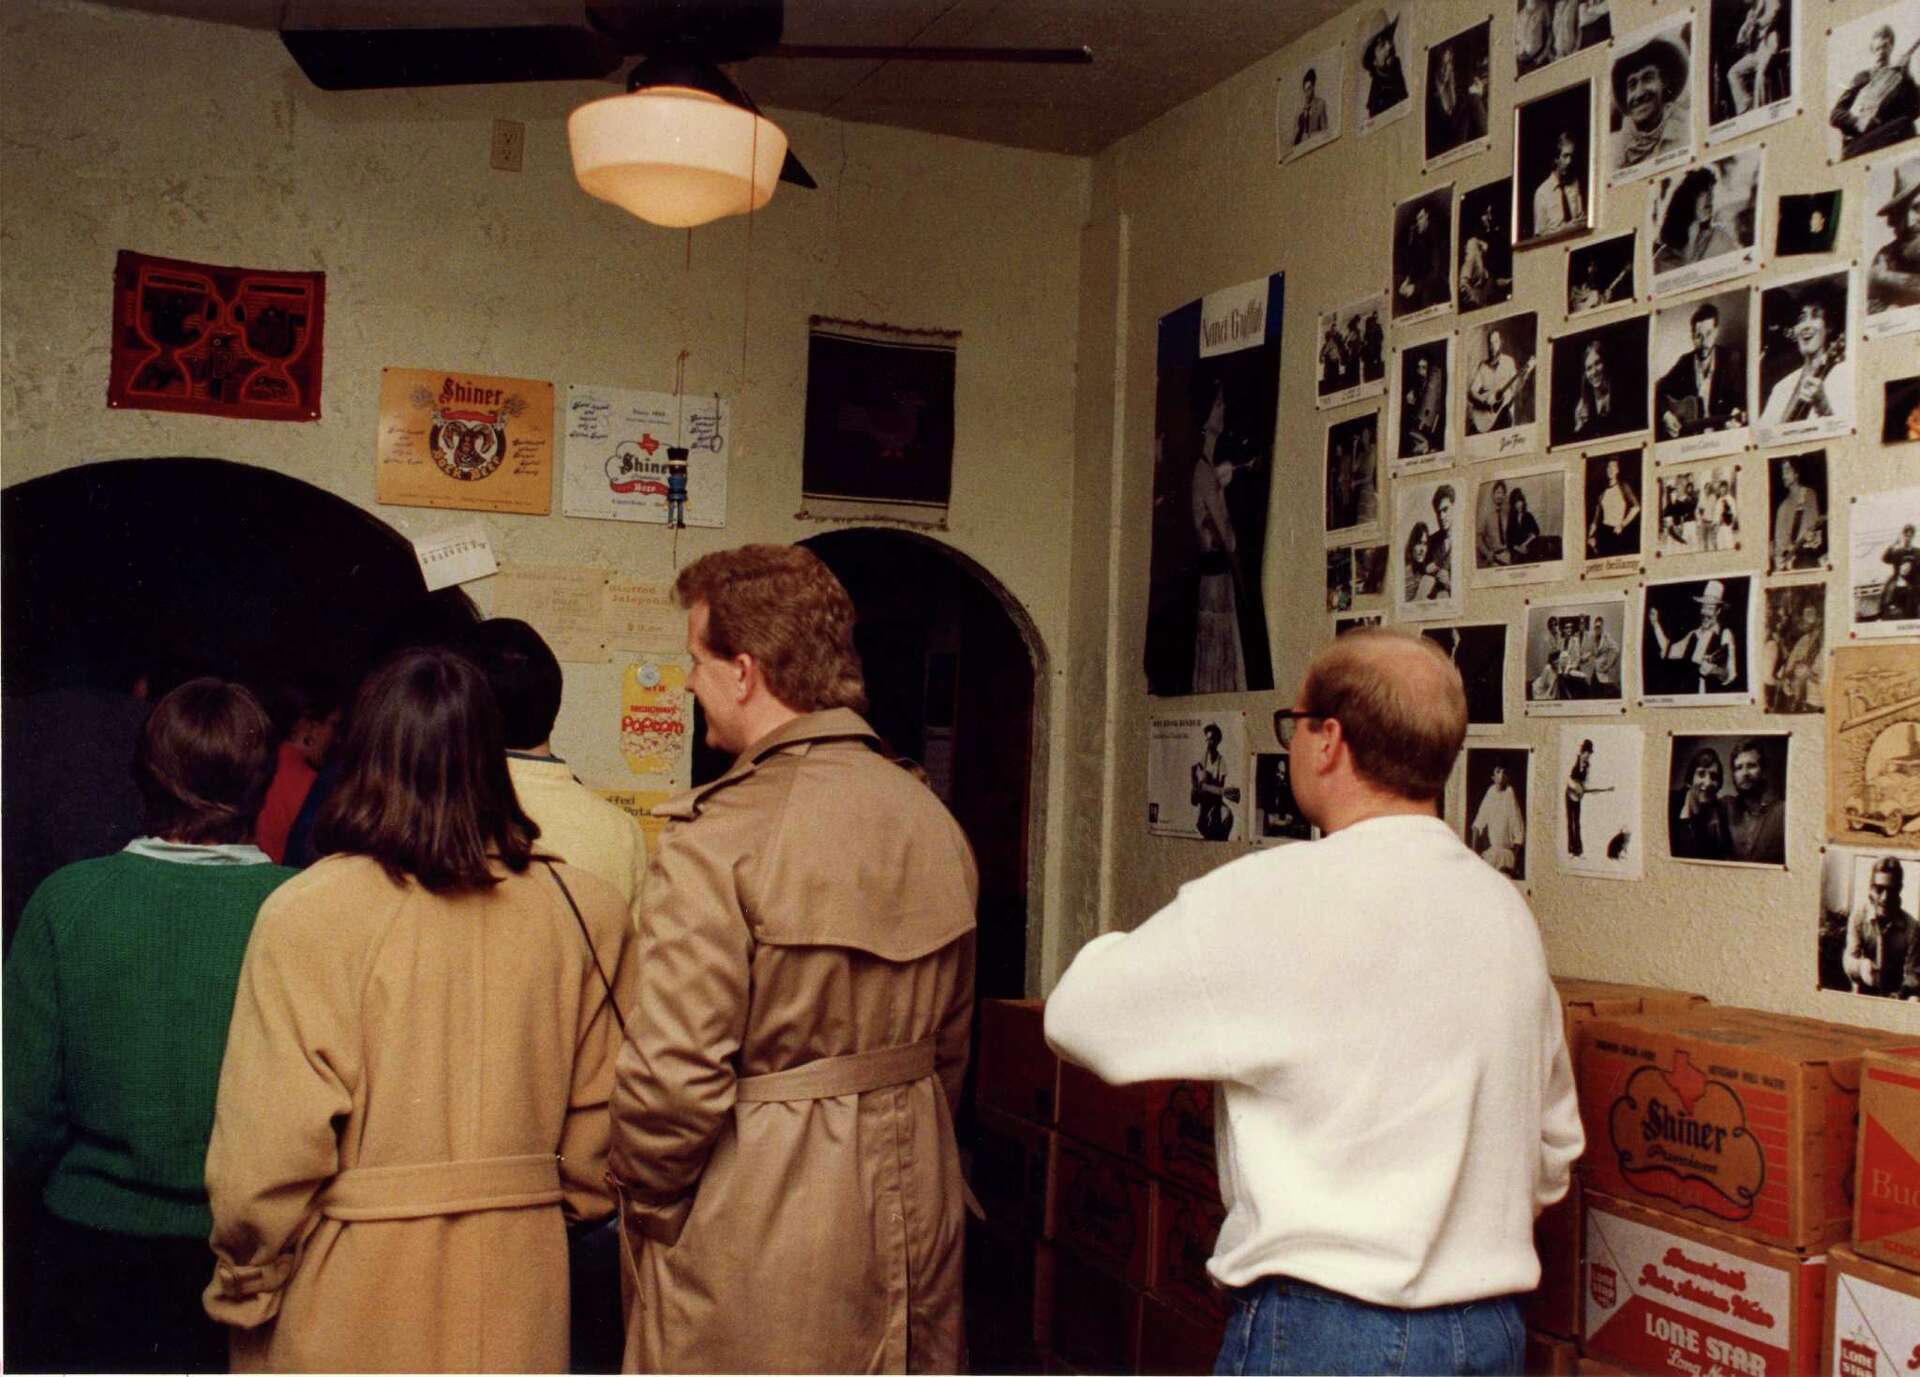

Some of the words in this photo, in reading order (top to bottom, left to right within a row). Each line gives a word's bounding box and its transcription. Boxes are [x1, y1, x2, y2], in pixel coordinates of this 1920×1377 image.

[437, 377, 504, 406] Shiner
[620, 452, 671, 475] Shine
[1641, 1097, 1729, 1154] Shiner
[1644, 1312, 1700, 1354] LONE
[1705, 1335, 1767, 1376] STAR
